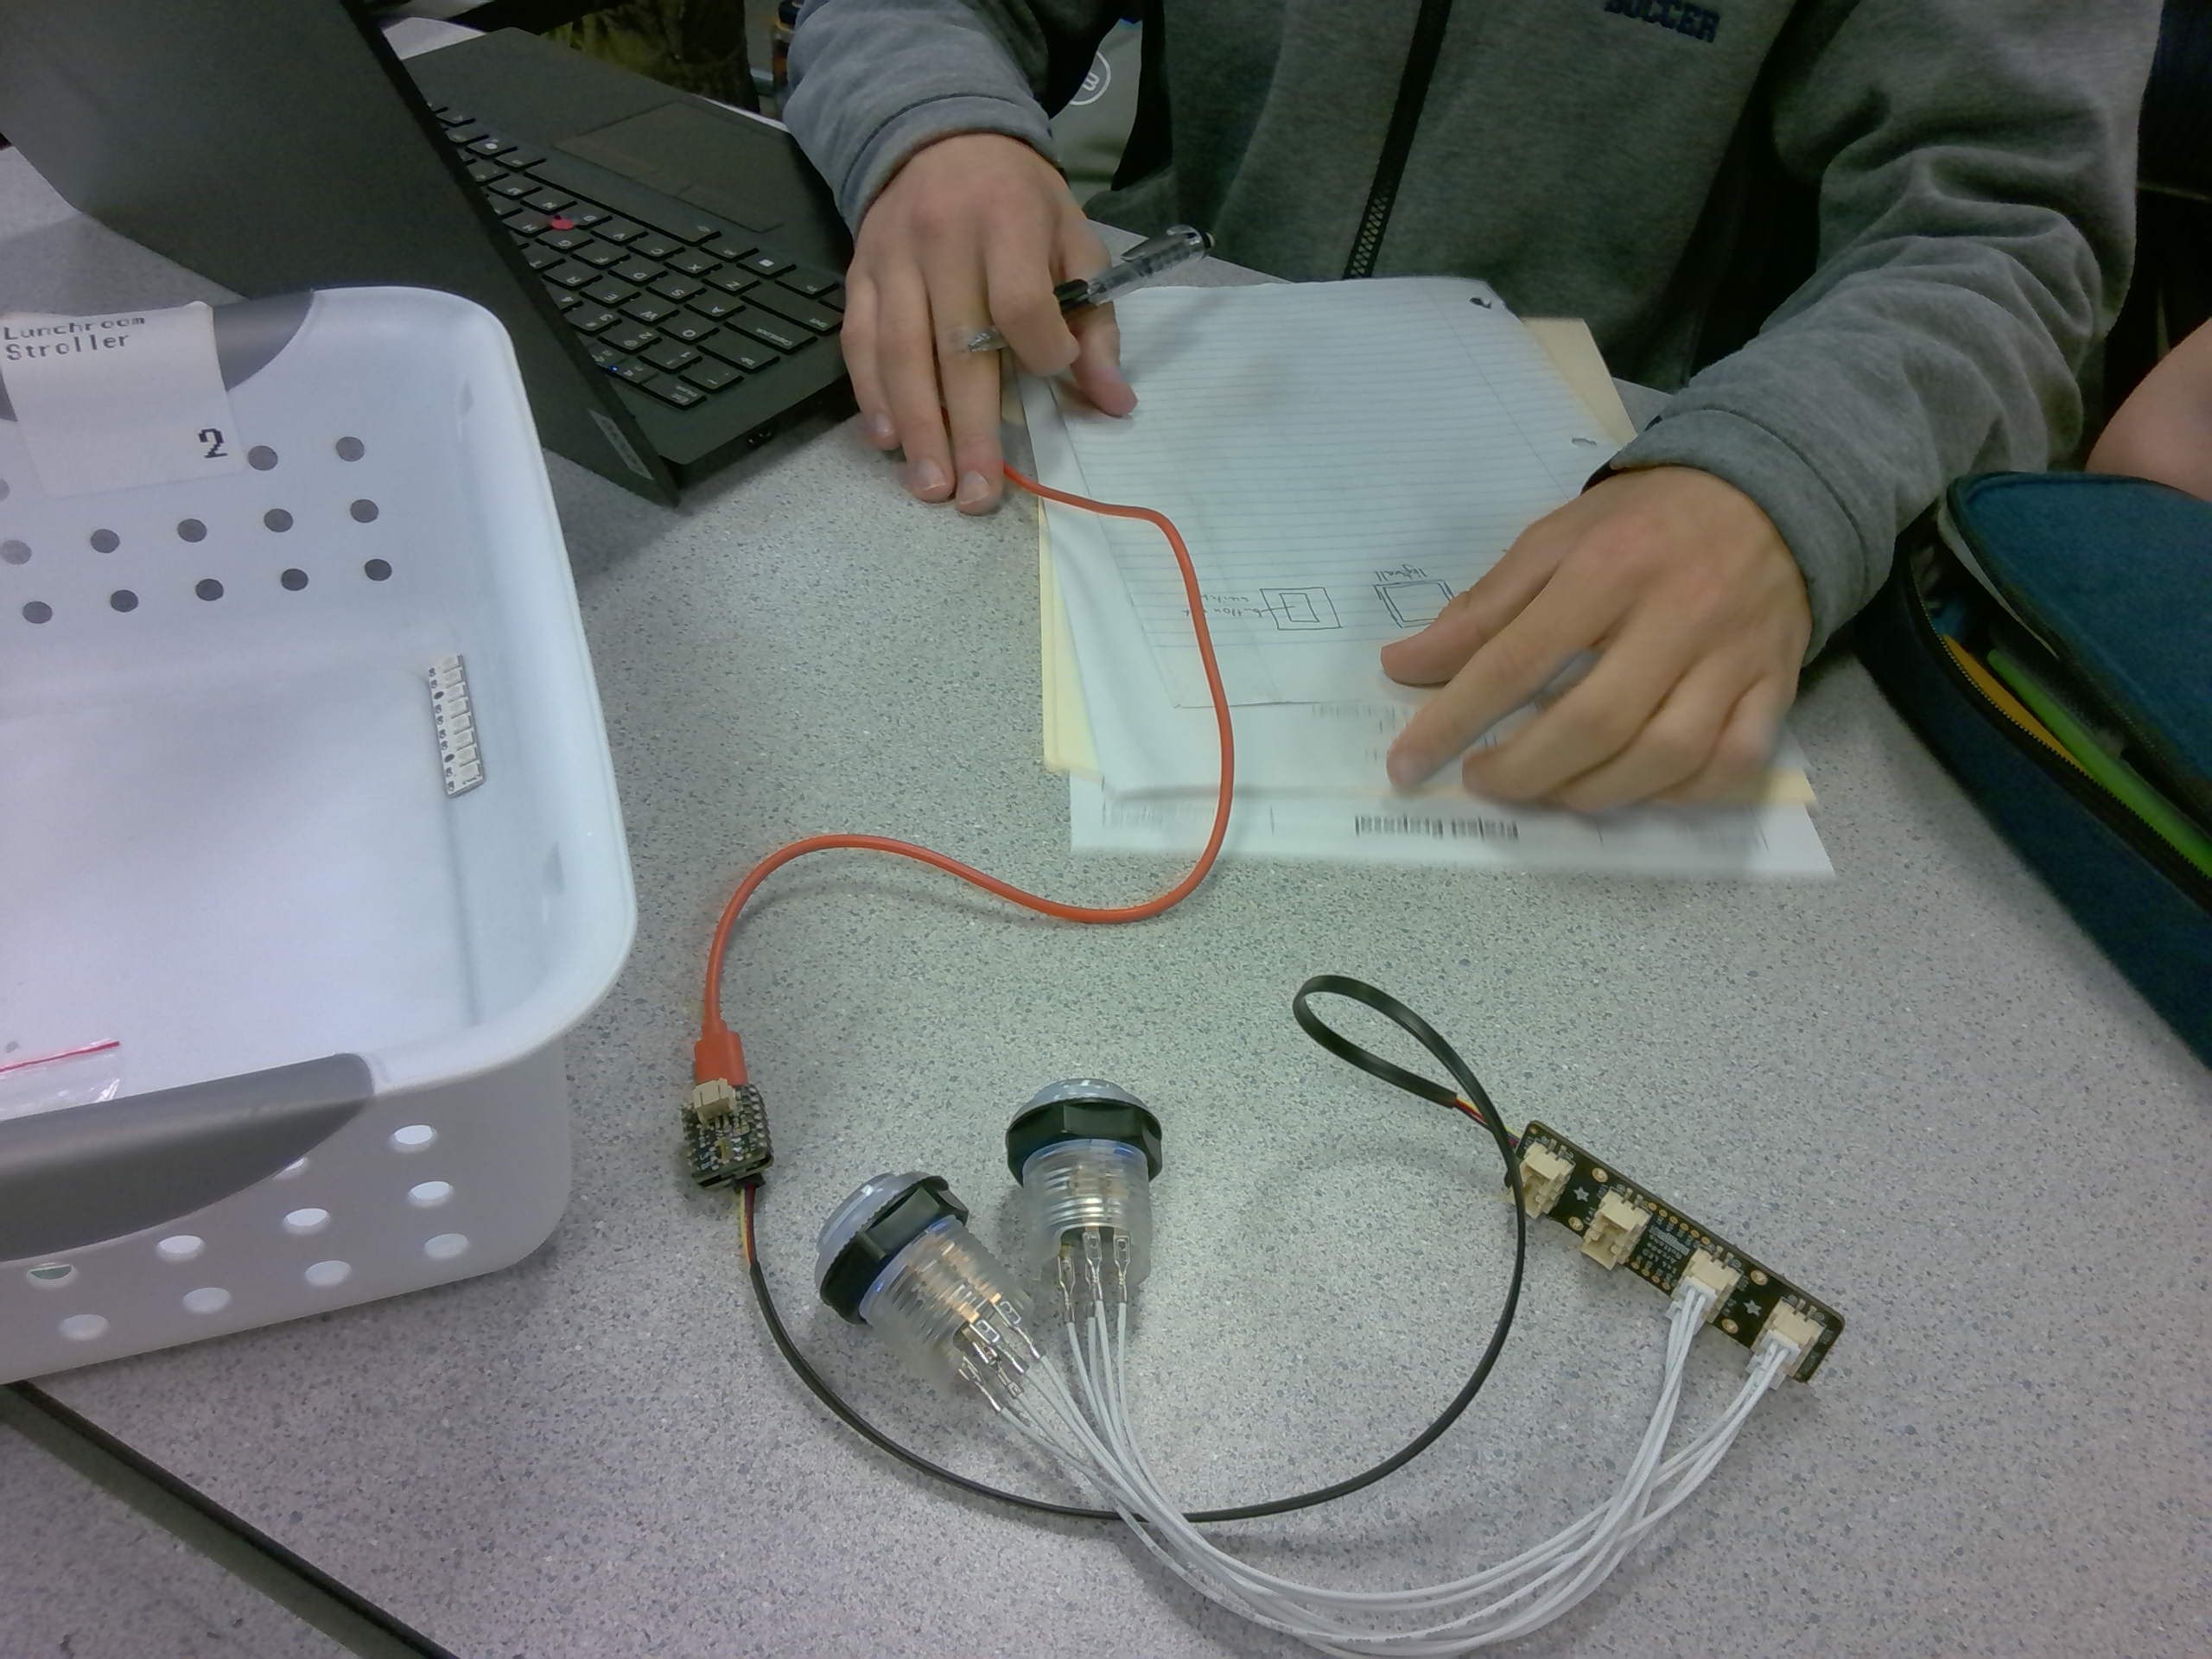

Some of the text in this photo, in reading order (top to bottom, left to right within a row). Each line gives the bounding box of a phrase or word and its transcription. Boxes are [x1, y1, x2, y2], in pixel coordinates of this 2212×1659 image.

[3, 316, 145, 340] Lunchroom
[5, 334, 129, 361] Stroller
[198, 428, 229, 459] 2
